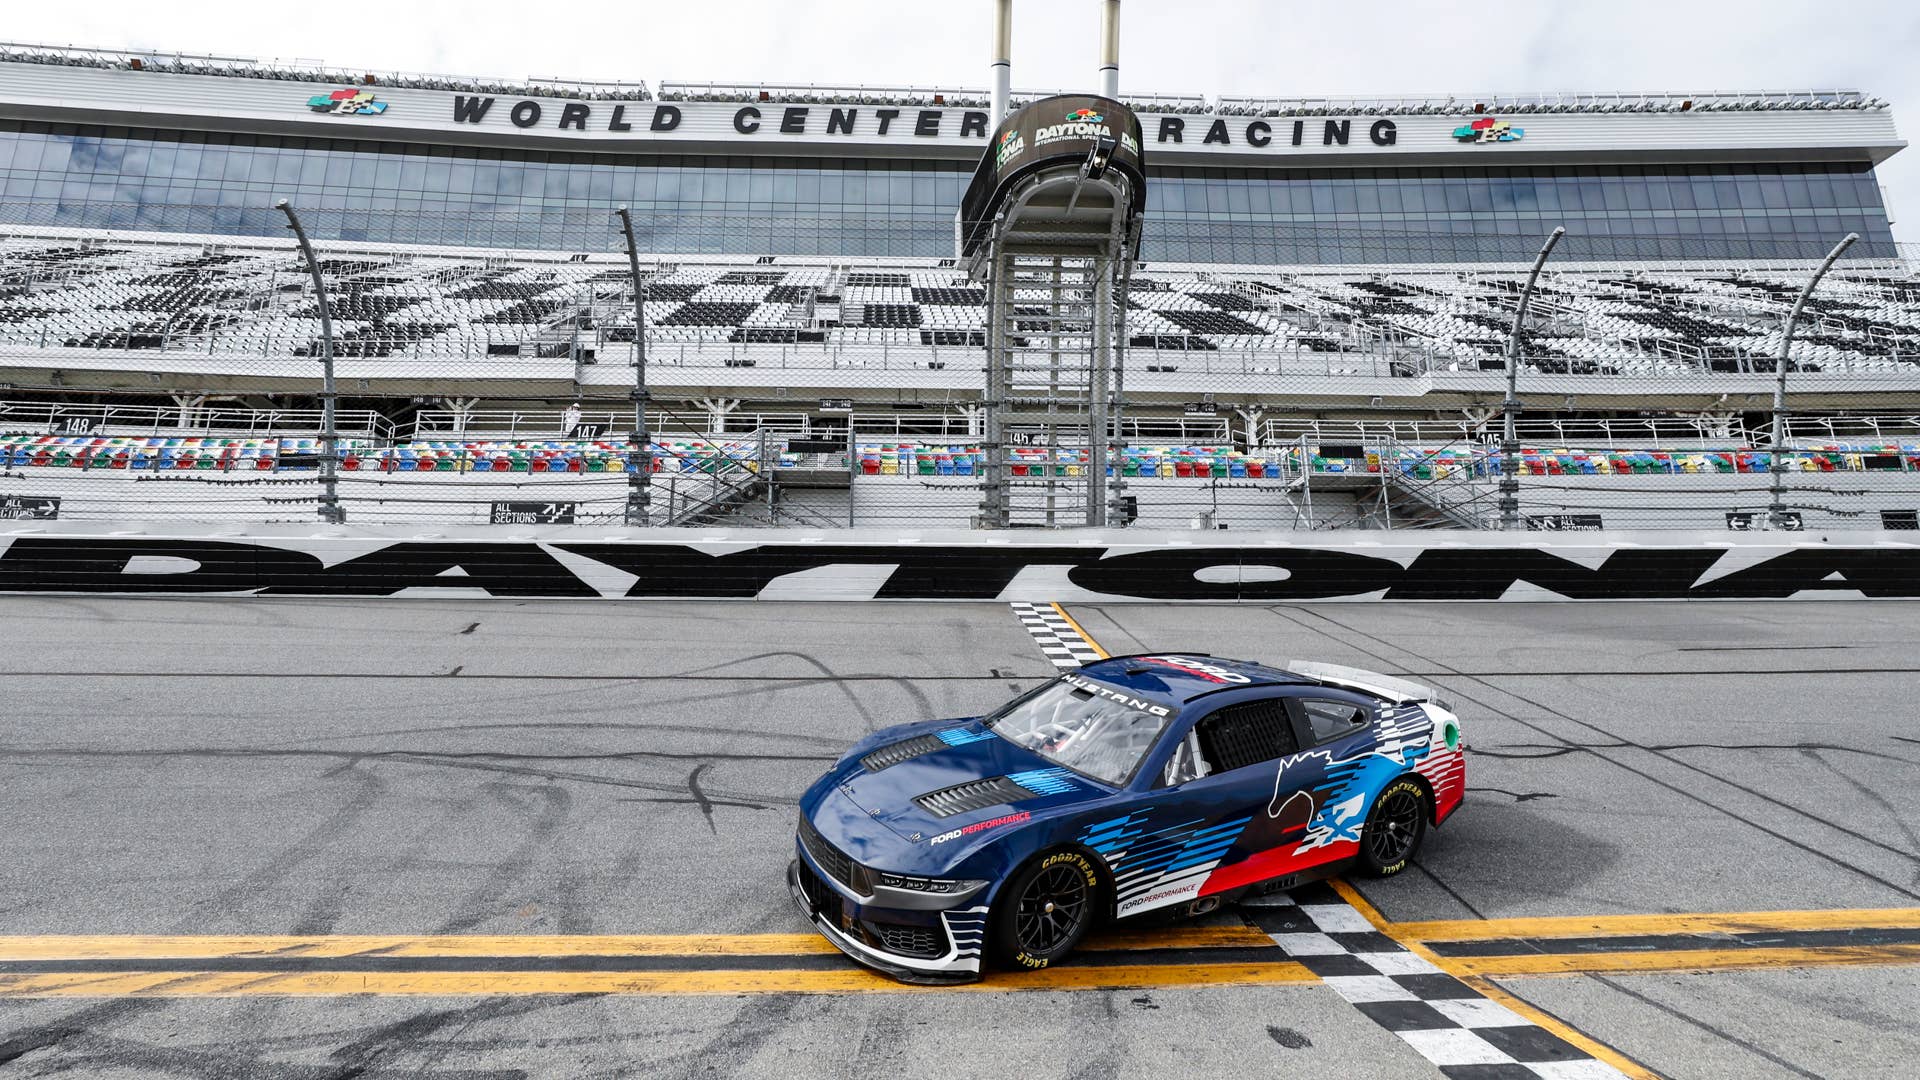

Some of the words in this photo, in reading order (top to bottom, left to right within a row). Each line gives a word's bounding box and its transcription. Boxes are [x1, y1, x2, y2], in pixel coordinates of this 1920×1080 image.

[454, 96, 682, 131] WORLD
[733, 106, 989, 138] CENTER
[1157, 117, 1398, 147] RACING
[1035, 123, 1111, 142] DAYTONA
[66, 418, 89, 434] 148
[576, 425, 598, 441] 147
[1480, 433, 1501, 449] 145
[495, 503, 512, 512] ALL
[495, 512, 537, 523] SECTIONS
[0, 536, 1920, 601] DAYTONA
[1061, 673, 1170, 717] MUSTANG
[1042, 853, 1097, 888] GOODYEAR
[1382, 859, 1405, 874] EAGLE
[1016, 951, 1049, 969] EAGLE
